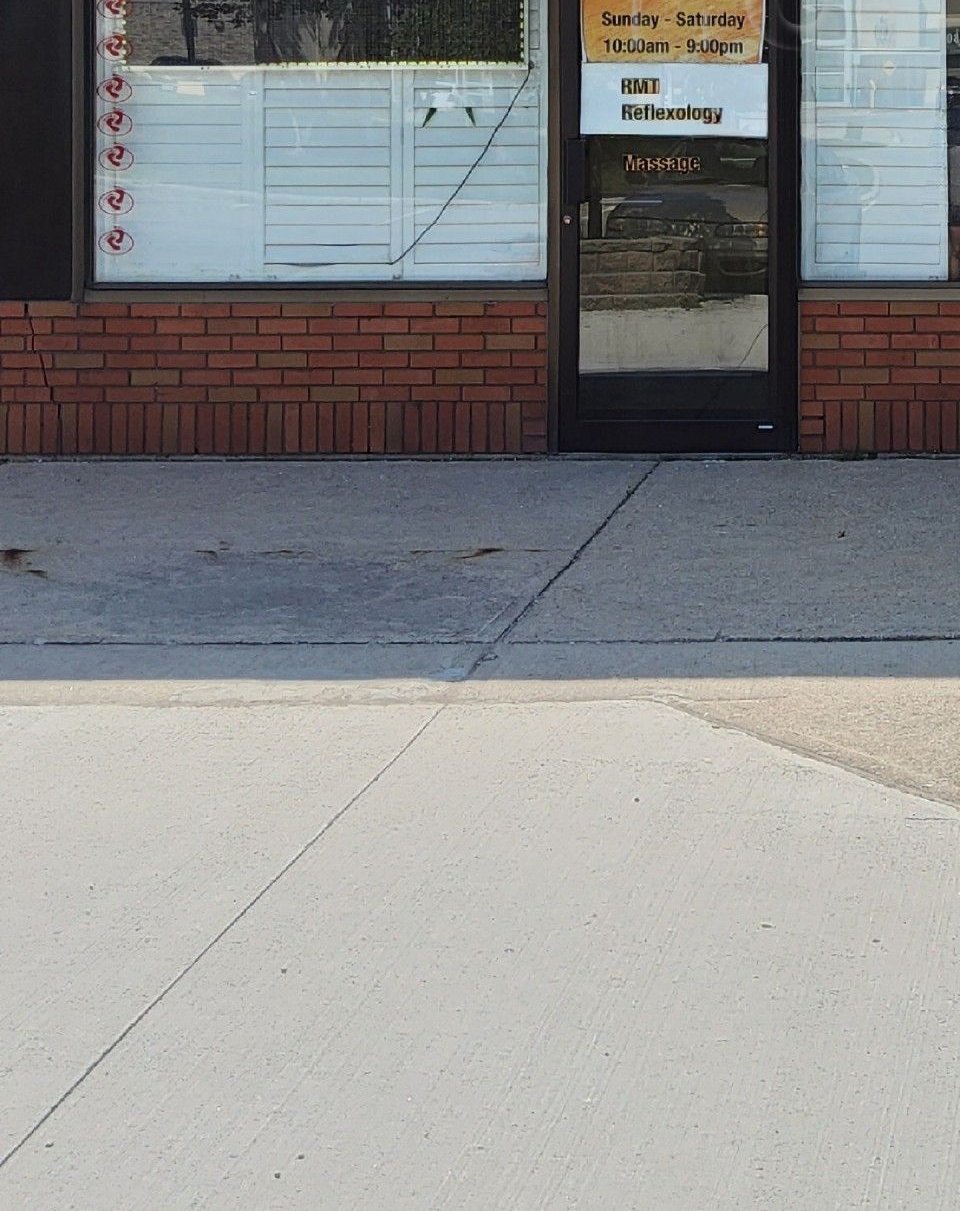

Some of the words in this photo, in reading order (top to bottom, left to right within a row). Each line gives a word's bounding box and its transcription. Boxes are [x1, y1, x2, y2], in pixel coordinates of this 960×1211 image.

[601, 11, 659, 30] Sunday
[676, 11, 745, 30] Saturday
[603, 39, 669, 54] 10:00am
[686, 39, 744, 56] 9:00pm
[621, 78, 660, 94] RMT
[621, 103, 723, 124] Reflexology
[623, 153, 700, 174] Massage
